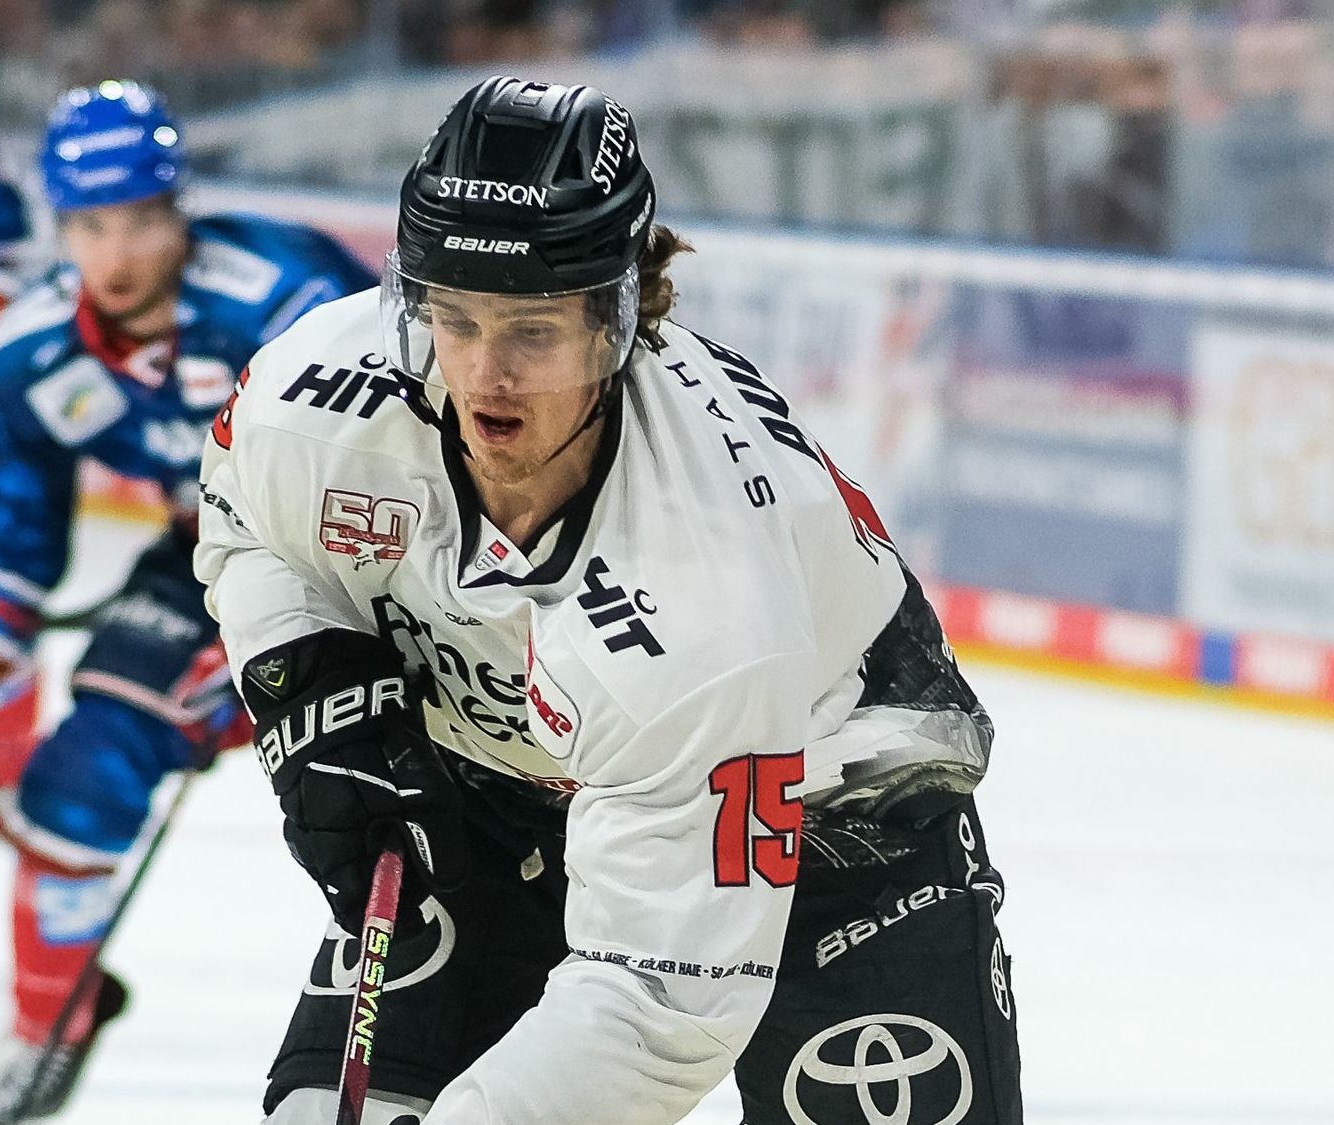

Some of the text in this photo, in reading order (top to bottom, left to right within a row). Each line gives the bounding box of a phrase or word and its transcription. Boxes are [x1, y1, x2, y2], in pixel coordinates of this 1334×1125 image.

[438, 176, 548, 208] STETSON
[444, 235, 530, 255] BAUER
[709, 749, 804, 888] 15
